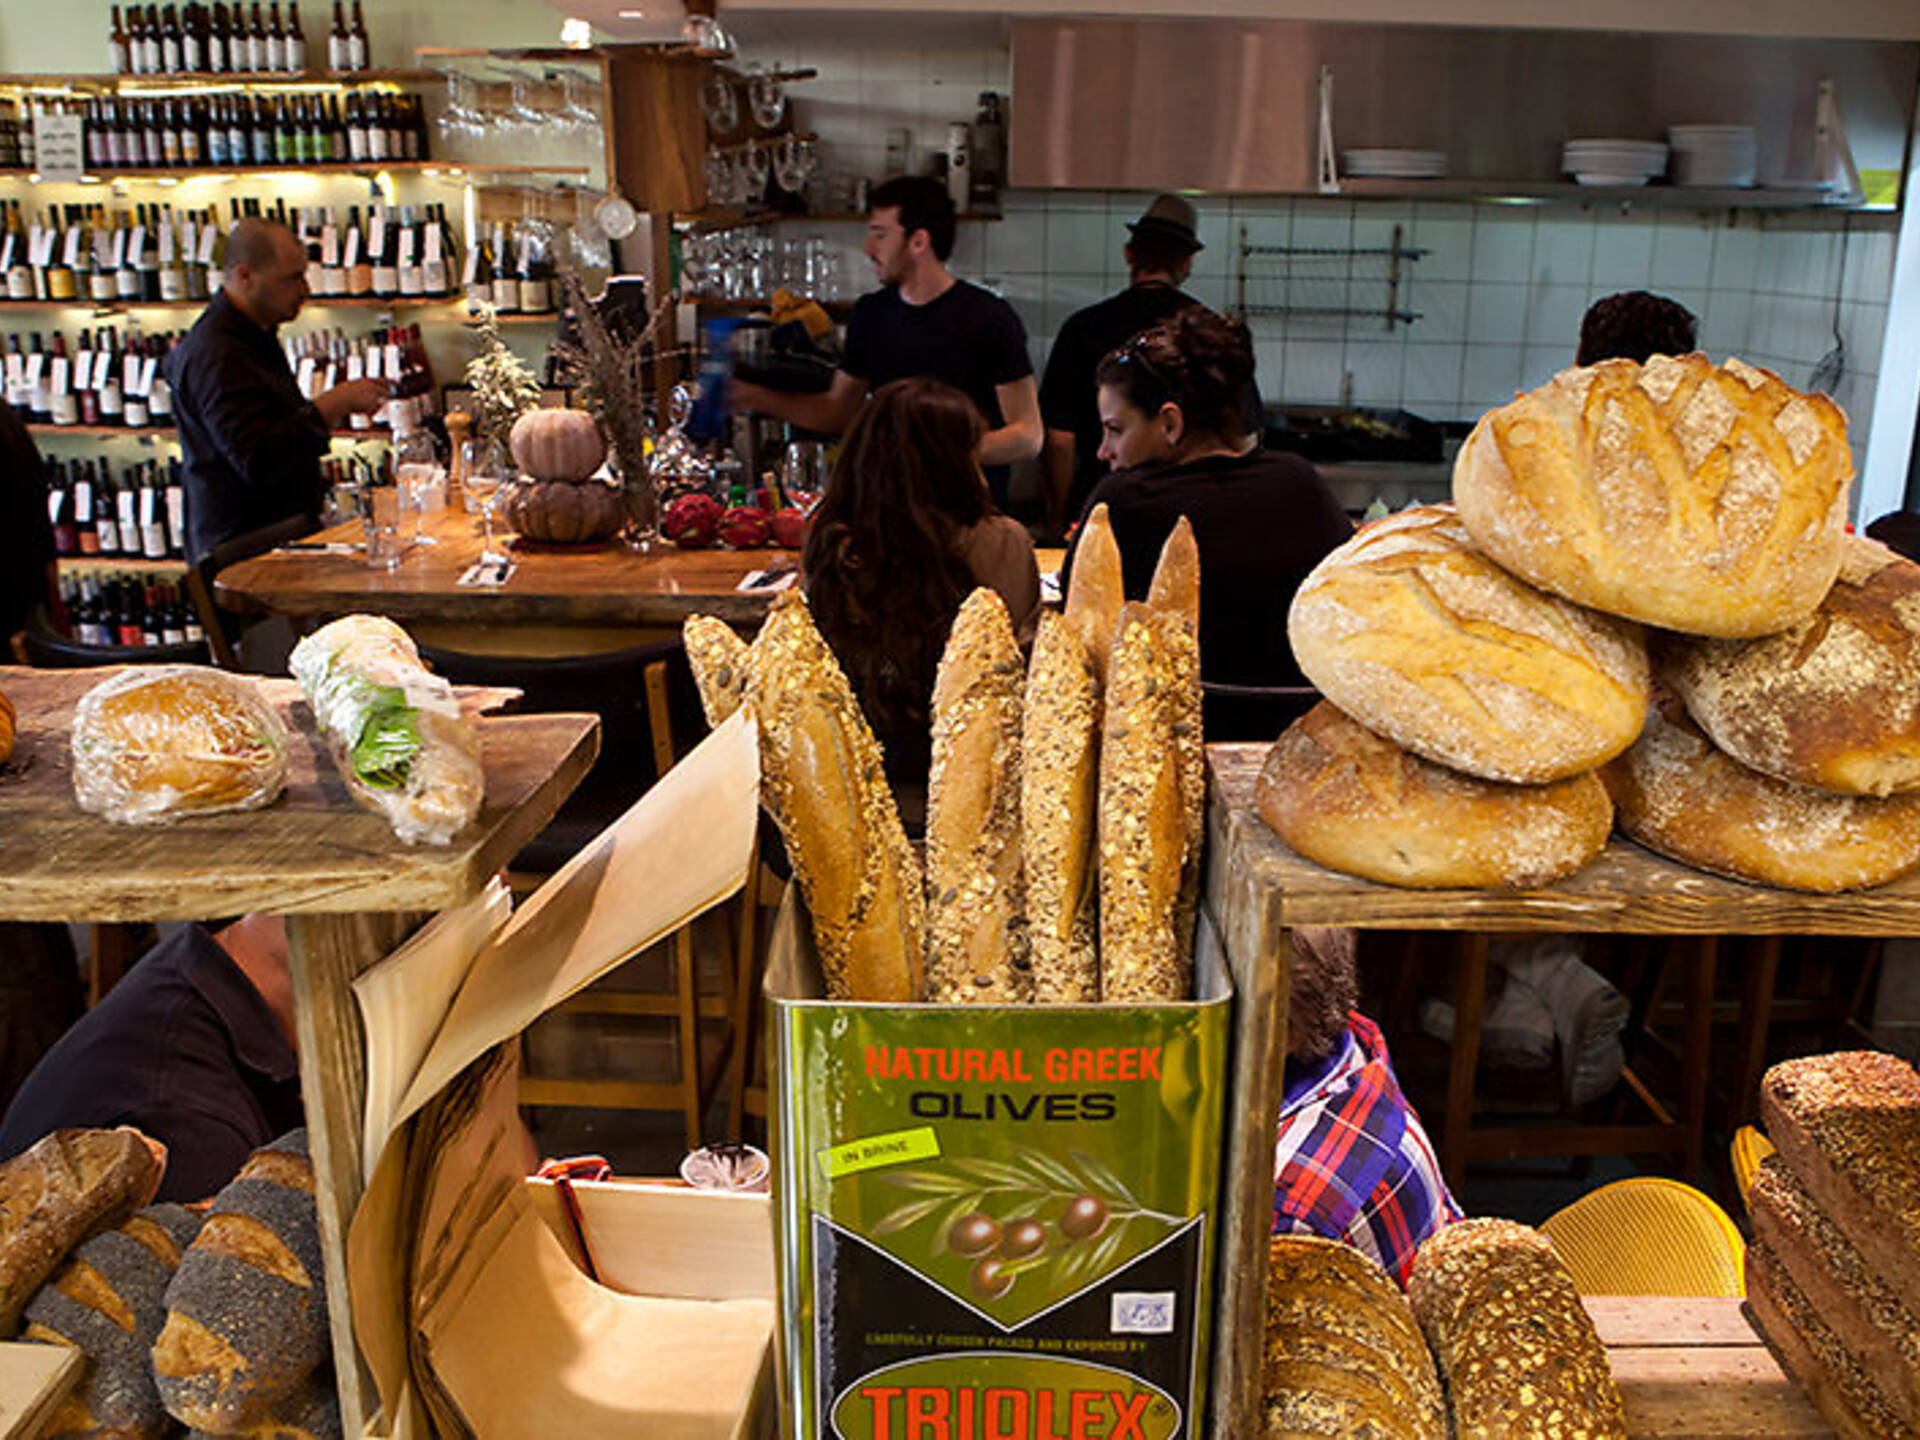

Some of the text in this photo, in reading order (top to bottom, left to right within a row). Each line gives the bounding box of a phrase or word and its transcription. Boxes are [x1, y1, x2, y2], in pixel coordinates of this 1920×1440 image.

[865, 1046, 1163, 1083] NATURAL GREEK
[910, 1091, 1117, 1121] OLIVES
[841, 1140, 908, 1164] IN BRINE
[861, 1387, 1152, 1440] TRIOLEX
